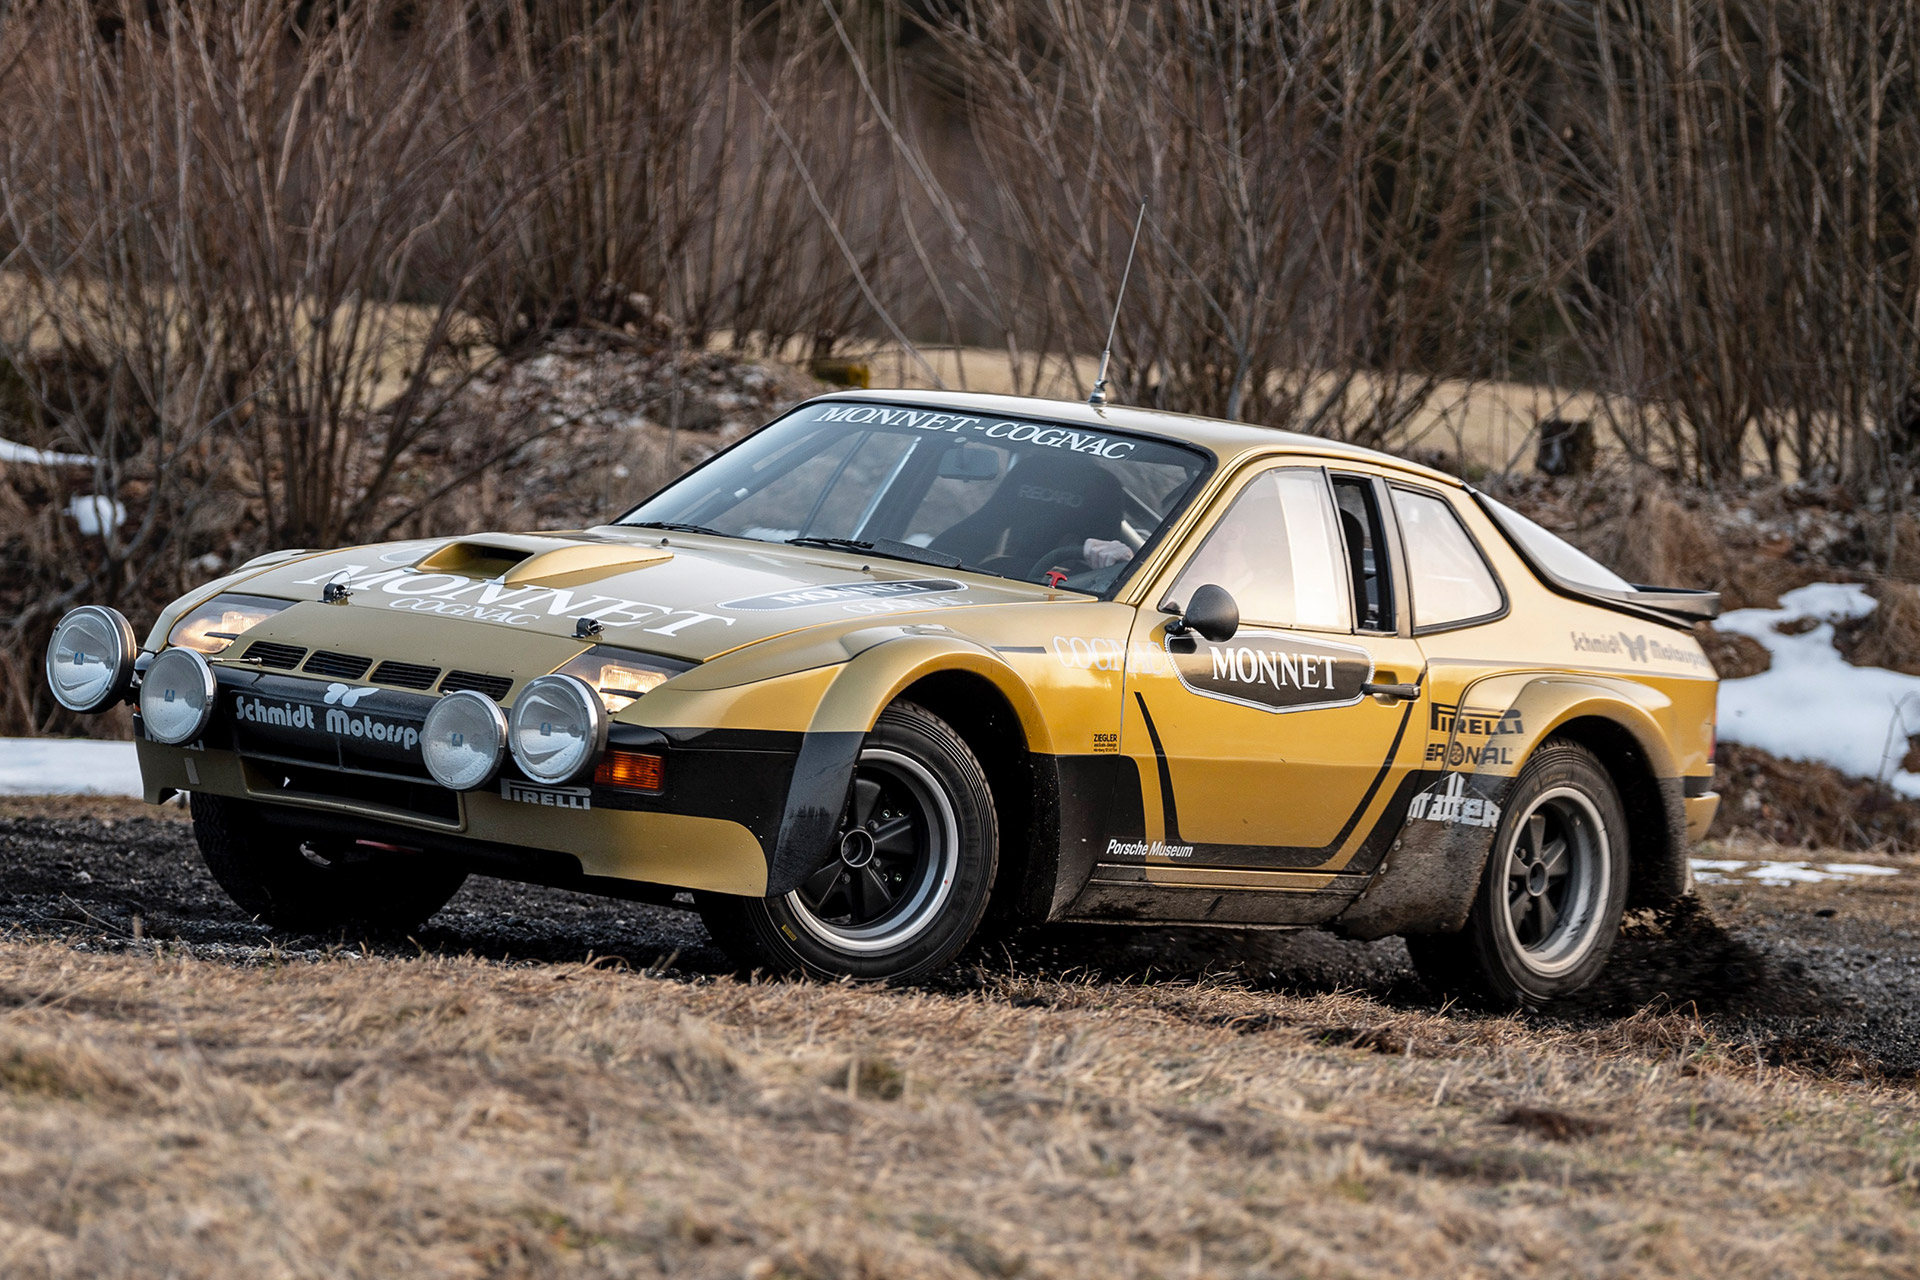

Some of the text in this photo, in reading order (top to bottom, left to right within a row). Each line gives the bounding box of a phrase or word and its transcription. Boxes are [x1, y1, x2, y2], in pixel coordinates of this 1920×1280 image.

[812, 406, 1136, 460] MONNET-COGNAC
[293, 565, 736, 637] MONNET
[769, 583, 929, 605] MONNET
[388, 597, 541, 626] COGNAC
[1052, 635, 1165, 675] COGNAC
[1209, 646, 1337, 690] MONNET
[235, 695, 315, 730] Schmidt
[1430, 702, 1524, 735] PIRELLI
[1094, 733, 1117, 742] ZIEGLER
[1425, 741, 1513, 766] RONAL
[501, 778, 592, 810] PIRELLI
[1106, 839, 1194, 858] Porsche Museum
